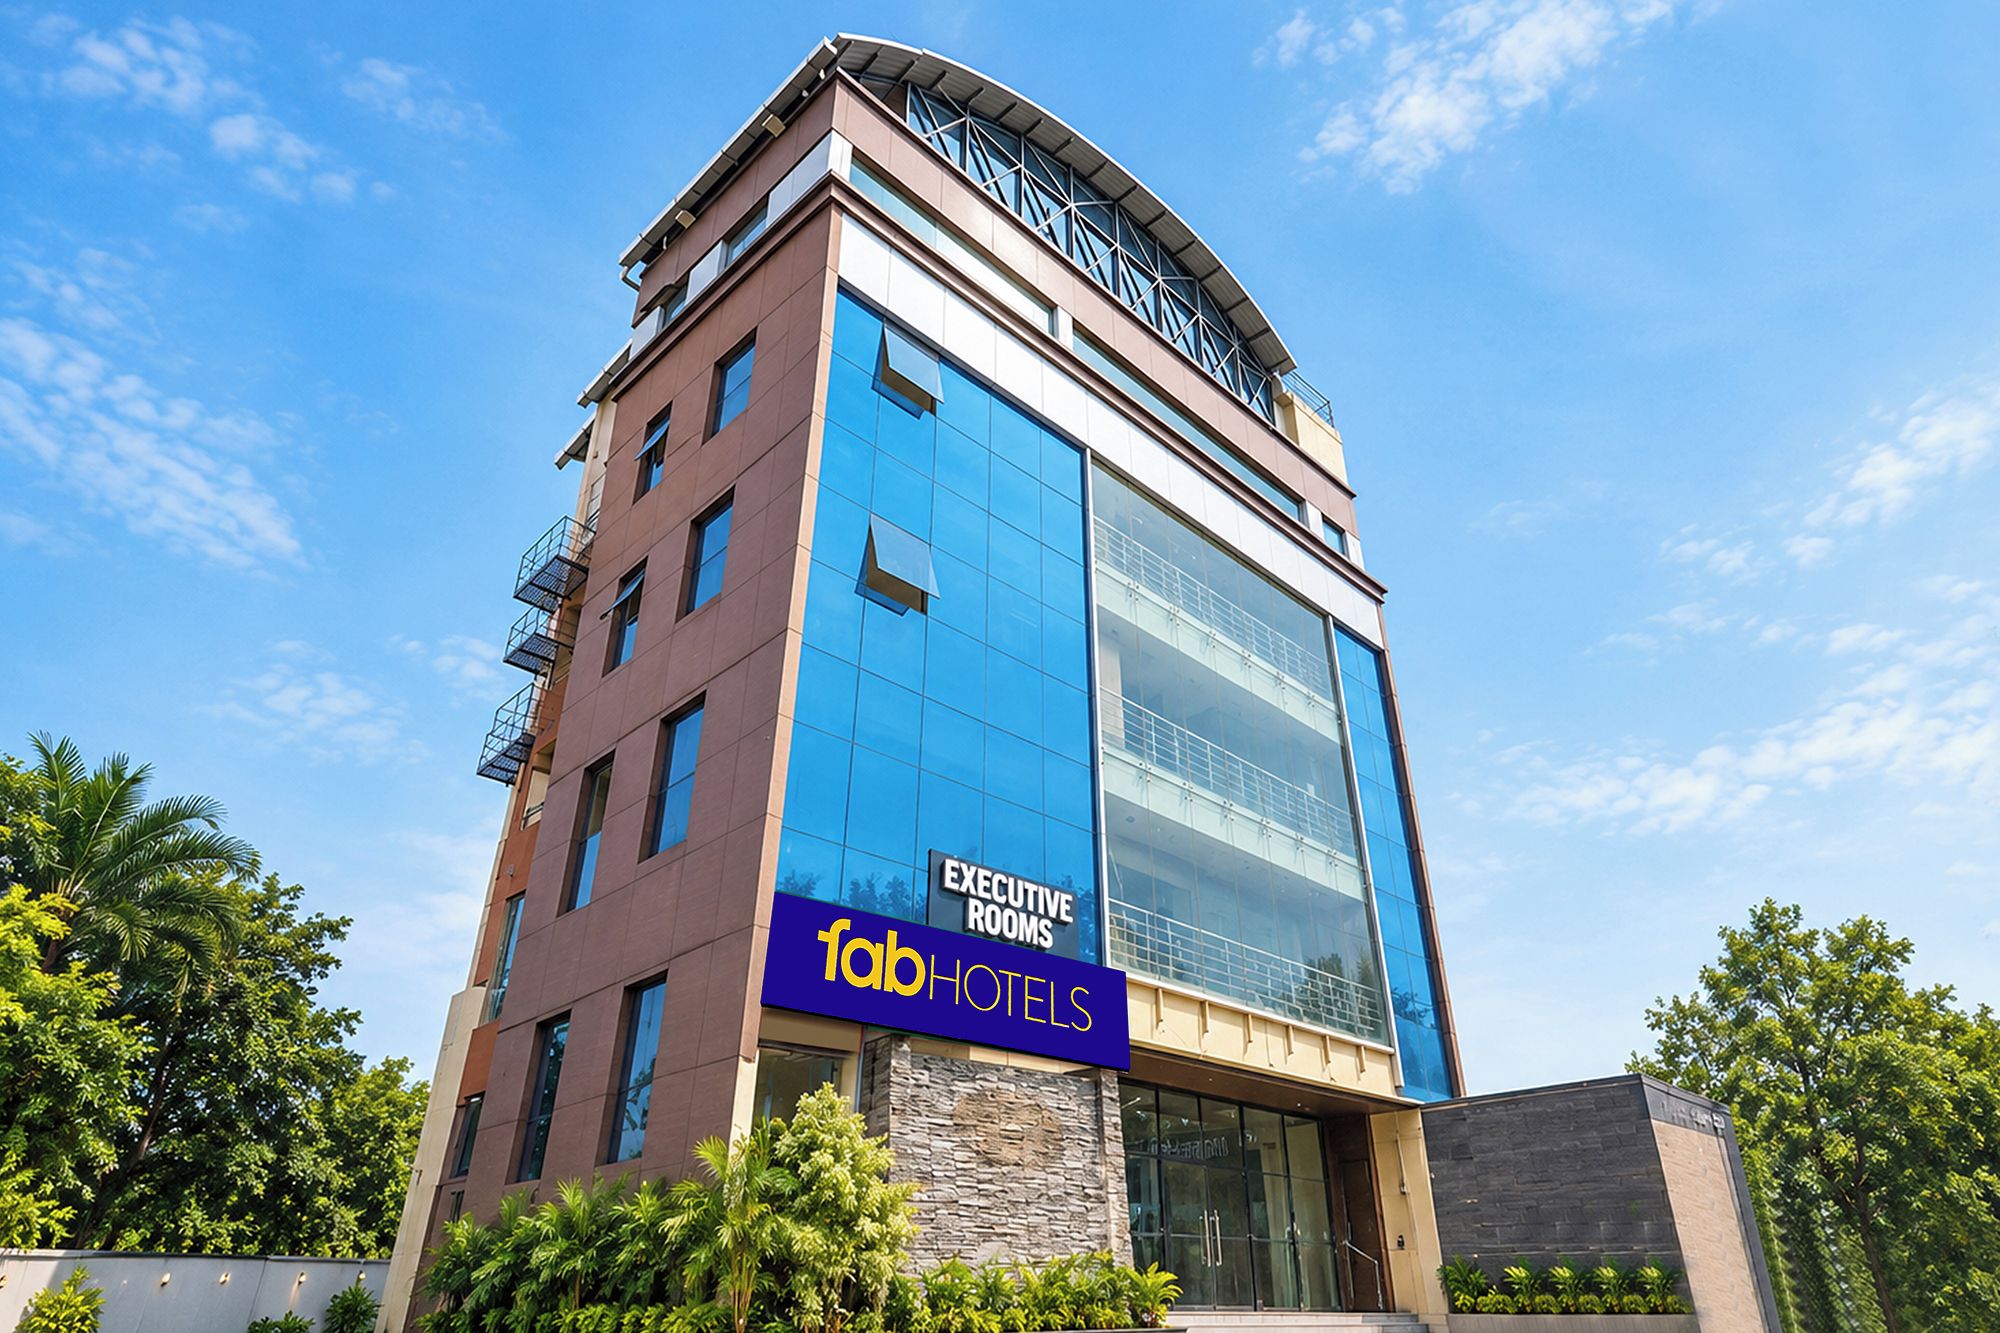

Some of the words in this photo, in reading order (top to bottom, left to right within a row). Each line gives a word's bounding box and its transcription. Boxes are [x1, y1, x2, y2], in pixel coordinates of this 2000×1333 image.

[944, 858, 1074, 924] EXECUTIVE
[967, 898, 1053, 949] ROOMS
[817, 918, 926, 997] fab
[929, 954, 1093, 1033] HOTELS
